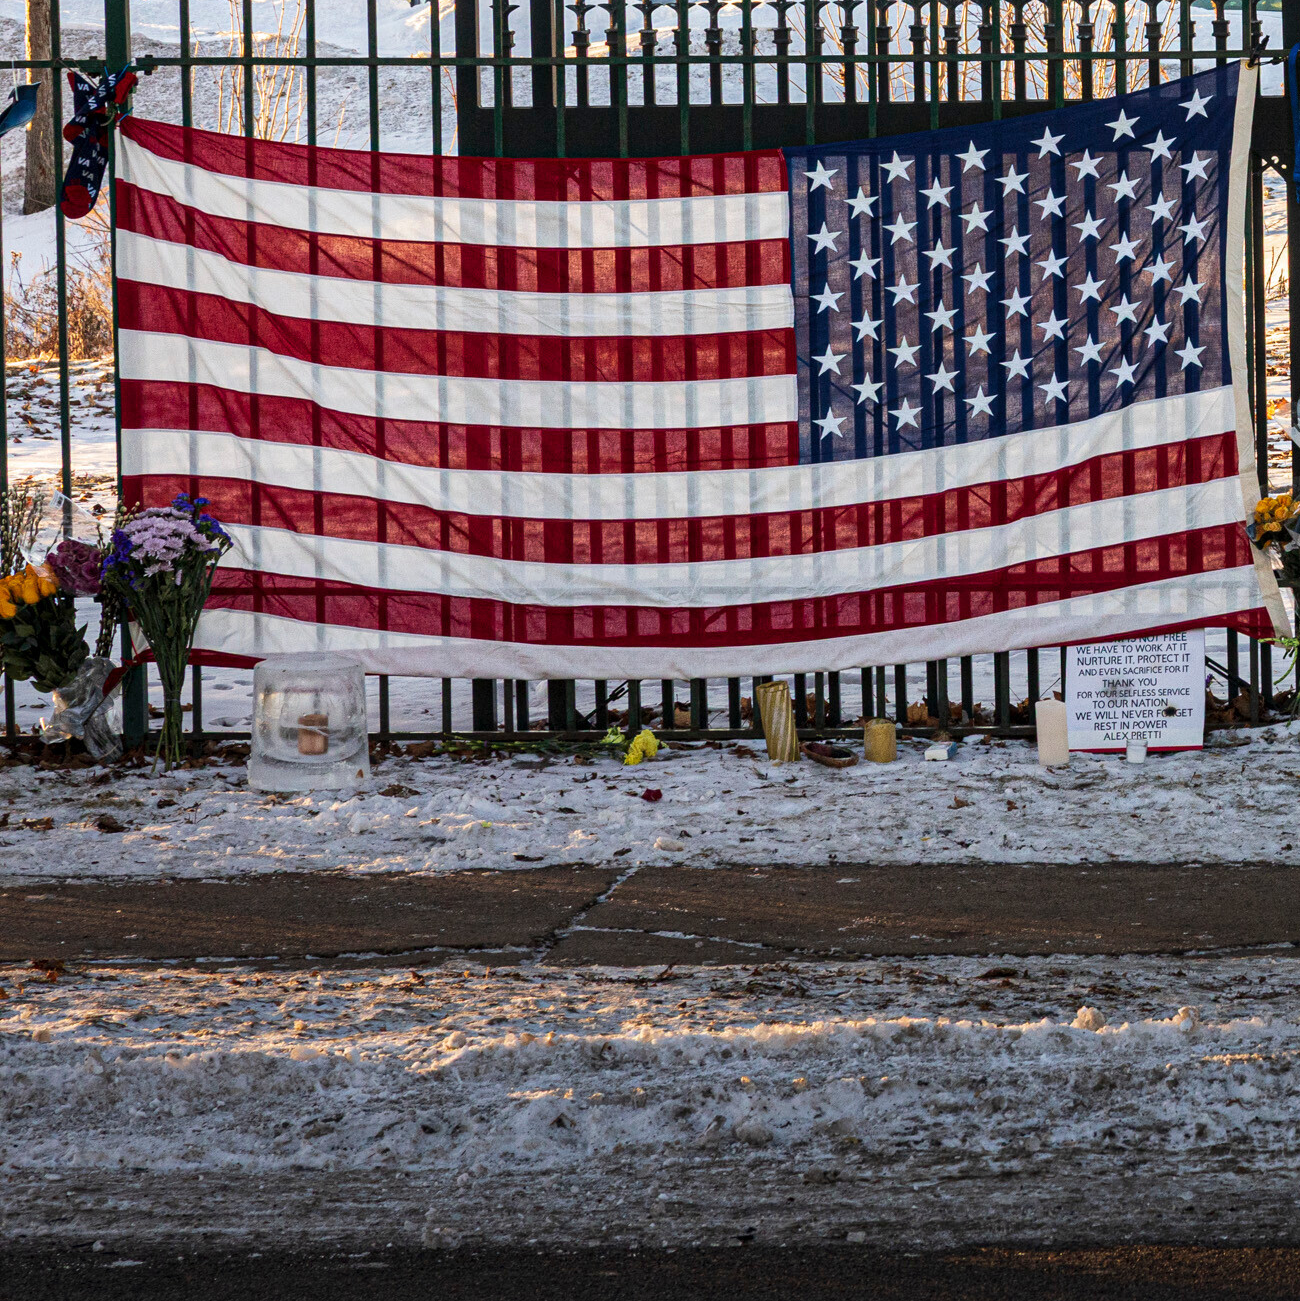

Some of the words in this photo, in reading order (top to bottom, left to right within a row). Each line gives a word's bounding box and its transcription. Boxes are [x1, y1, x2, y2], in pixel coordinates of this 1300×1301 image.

[77, 83, 90, 91] VA
[88, 96, 98, 110] VA
[78, 157, 90, 167] VA
[1163, 632, 1187, 642] FREE
[1093, 646, 1118, 654] HAVE
[1121, 645, 1133, 653] TO
[1135, 645, 1163, 653] WORK
[1180, 643, 1187, 651] IT
[1077, 656, 1122, 666] NURTURE
[1137, 654, 1179, 663] PROTECT
[1182, 653, 1191, 662] IT
[1078, 668, 1097, 676] AND
[1100, 667, 1120, 676] EVEN
[1122, 666, 1162, 675] SACRIFICE
[1164, 665, 1181, 673] FOR
[1182, 665, 1189, 673] IT
[1102, 679, 1135, 688] THANK
[1138, 678, 1158, 686] YOU
[1077, 691, 1093, 699] FOR
[1095, 690, 1117, 698] YOUR
[1119, 689, 1156, 698] SELFLESS
[1158, 687, 1190, 696] SERVICE
[1092, 701, 1106, 709] TO
[1107, 700, 1128, 708] OUR
[1131, 698, 1168, 708] NATION
[1075, 712, 1092, 720] WE
[1095, 711, 1118, 720] WILL
[1122, 709, 1153, 719] NEVER
[1156, 708, 1193, 718] FOGET
[1094, 722, 1118, 731] REST
[1120, 721, 1130, 729] IN
[1132, 720, 1168, 729] POWER
[1103, 732, 1128, 741] ALEX
[1131, 731, 1162, 739] PRETTI
